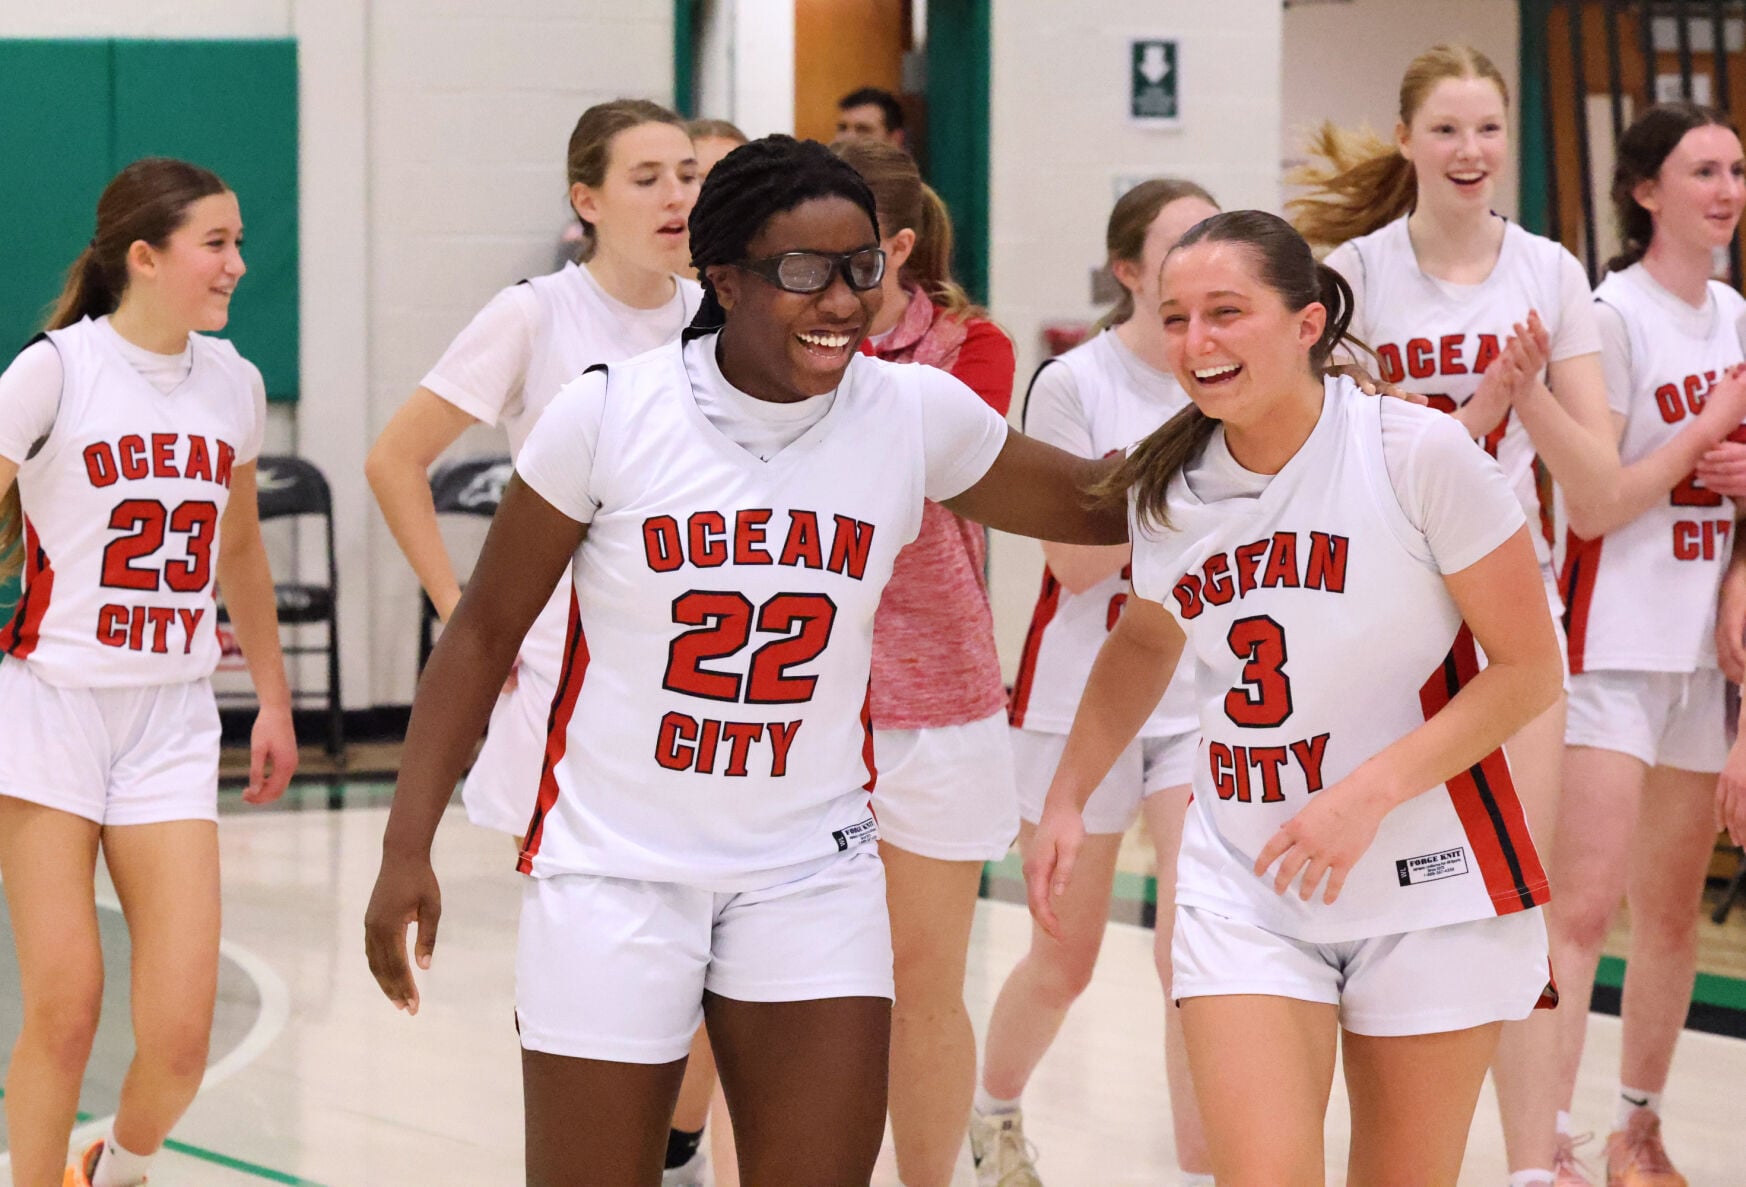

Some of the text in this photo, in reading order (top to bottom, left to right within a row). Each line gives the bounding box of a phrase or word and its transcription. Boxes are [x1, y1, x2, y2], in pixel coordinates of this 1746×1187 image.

[1376, 334, 1501, 384] OCEA
[83, 433, 236, 489] OCEAN
[100, 499, 218, 592] 23
[642, 508, 875, 581] OCEAN
[96, 603, 205, 654] CITY
[662, 589, 838, 704] 22
[1224, 614, 1293, 728] 3
[655, 711, 803, 777] CITY
[1209, 732, 1330, 803] CITY
[1410, 856, 1438, 867] FORGE
[1440, 850, 1461, 861] KNIT
